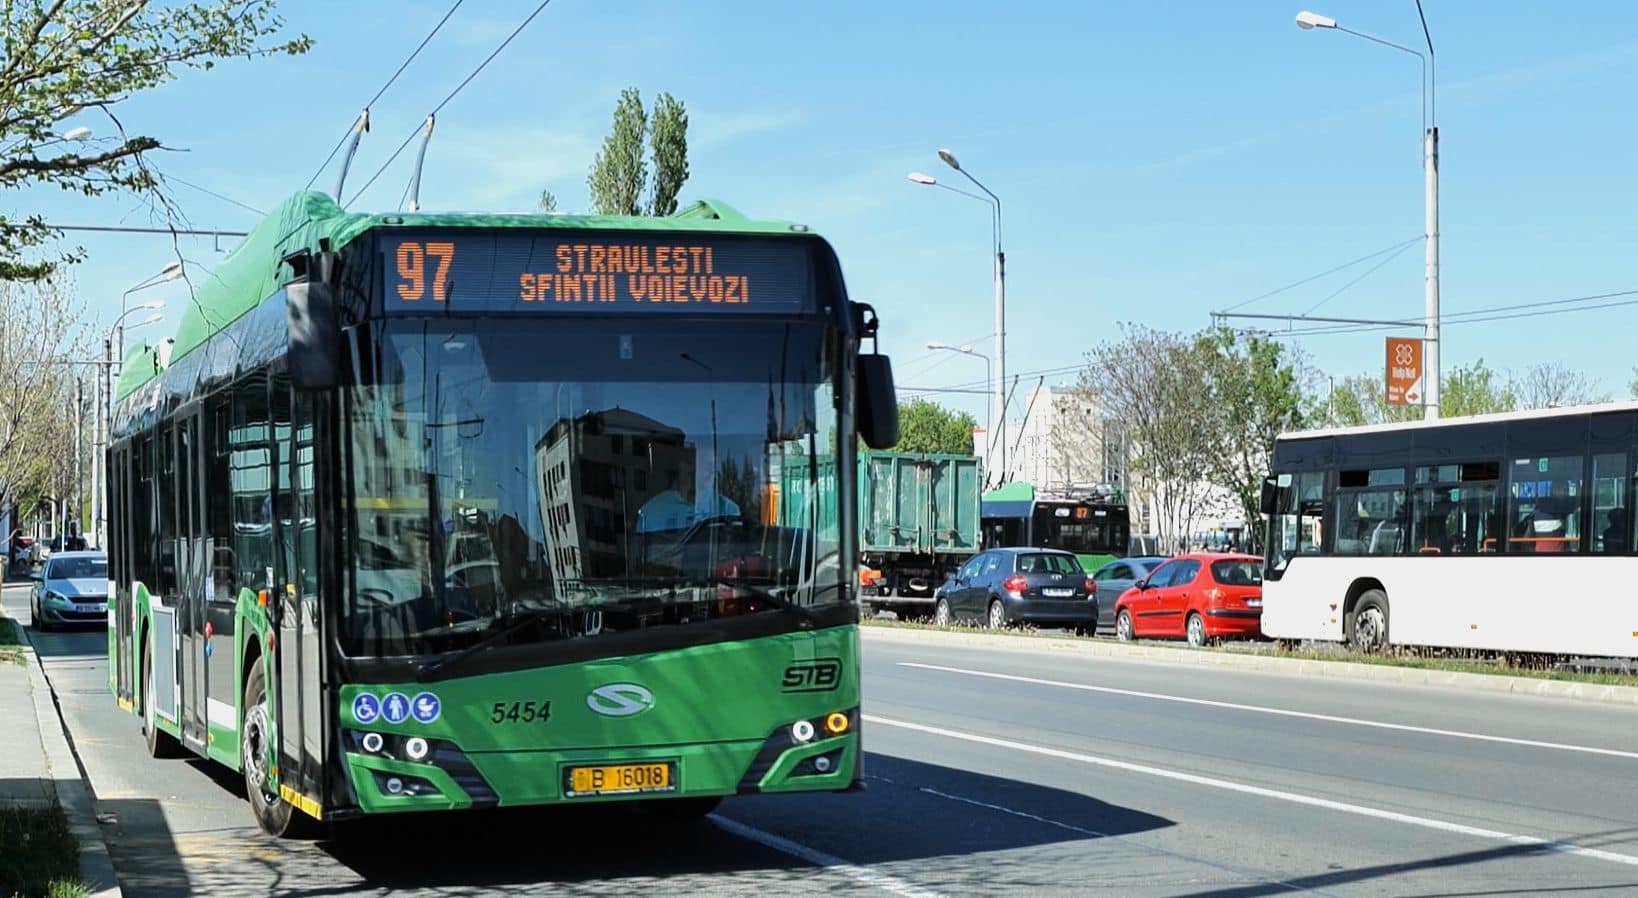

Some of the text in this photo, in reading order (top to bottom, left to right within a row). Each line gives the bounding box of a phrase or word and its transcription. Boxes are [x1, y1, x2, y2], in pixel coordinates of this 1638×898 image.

[397, 242, 455, 300] 97
[555, 245, 713, 274] STRAULESTI
[519, 273, 749, 303] SFINTII VOIEVOZI
[782, 663, 837, 687] STB
[491, 700, 551, 724] 5454
[592, 767, 663, 788] B 16018
